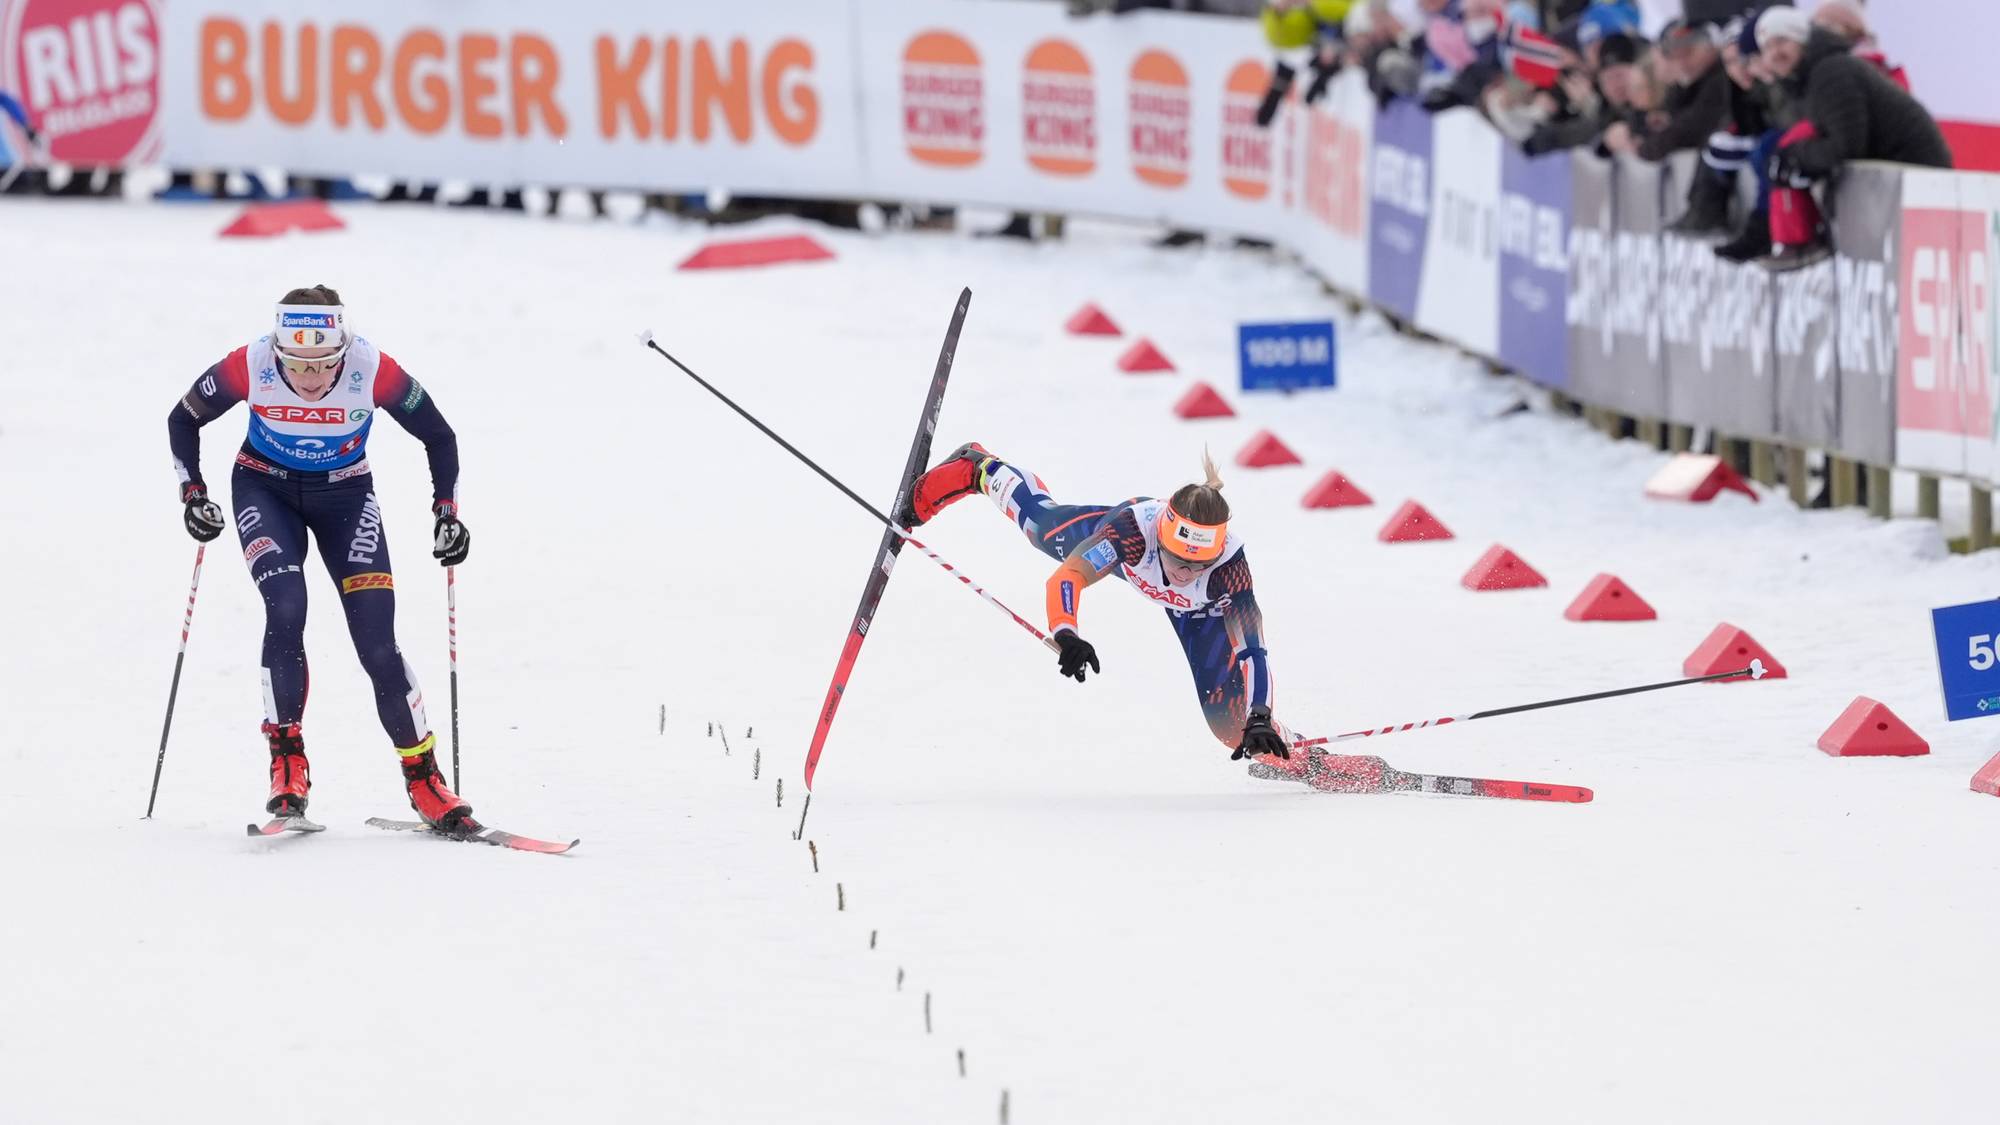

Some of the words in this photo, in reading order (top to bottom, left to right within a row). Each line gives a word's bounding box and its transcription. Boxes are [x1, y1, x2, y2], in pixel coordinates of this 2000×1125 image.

[24, 3, 153, 108] RIIS
[200, 18, 570, 139] BURGER
[594, 34, 820, 149] KING
[905, 104, 984, 141] KING
[284, 316, 326, 326] SpareBank
[1248, 337, 1296, 367] 100
[1300, 335, 1329, 364] M
[266, 408, 343, 421] SPAR
[245, 538, 273, 561] Gilde
